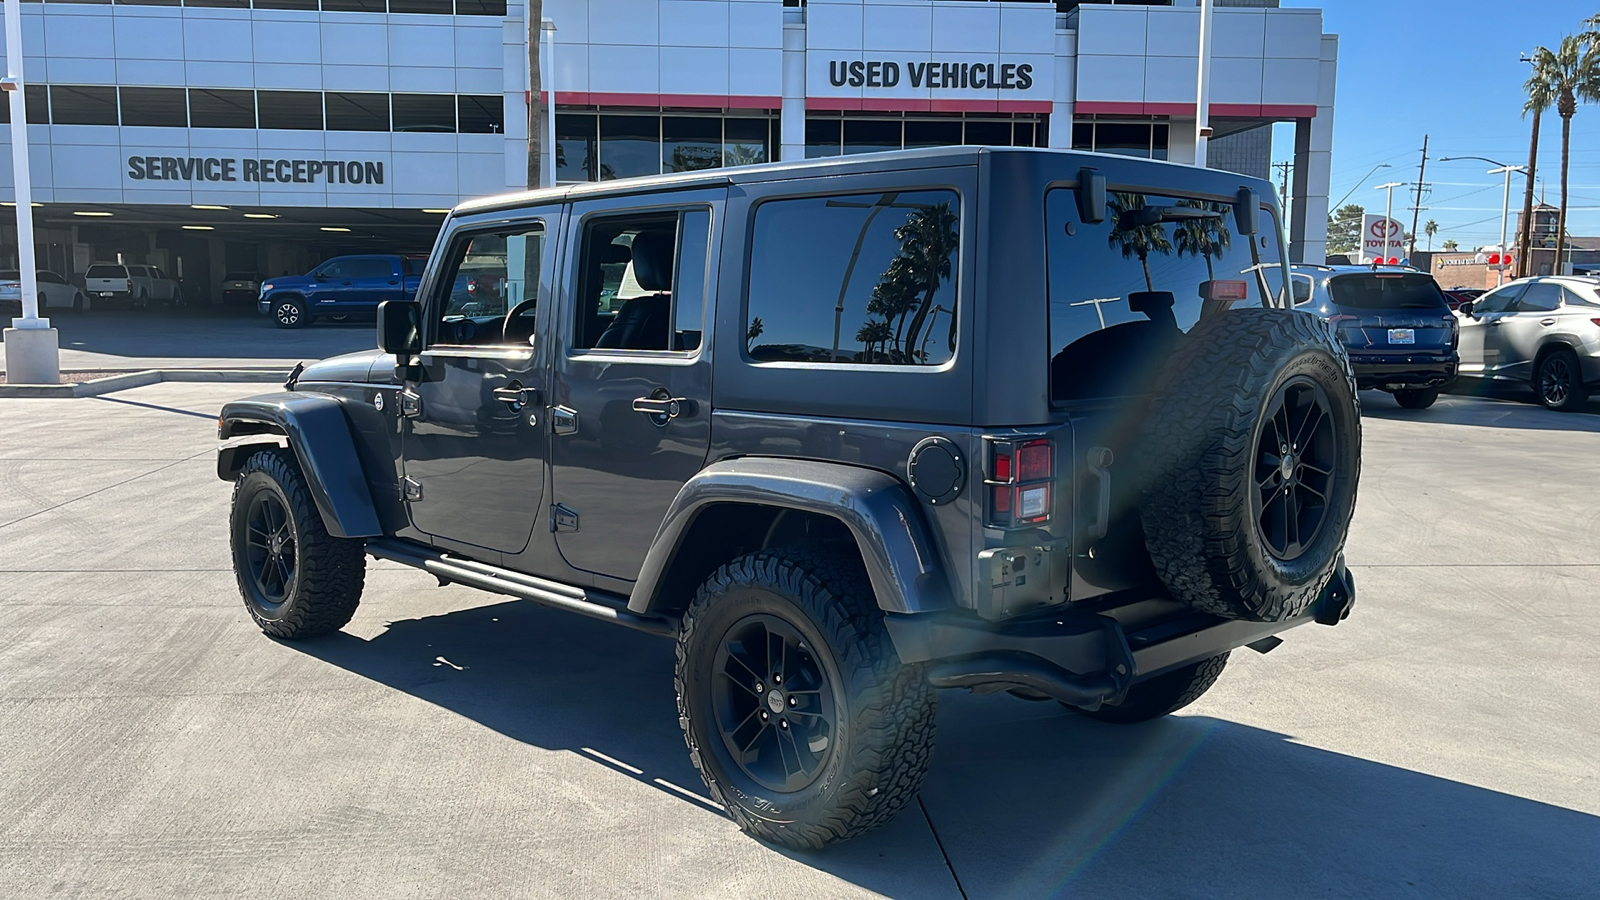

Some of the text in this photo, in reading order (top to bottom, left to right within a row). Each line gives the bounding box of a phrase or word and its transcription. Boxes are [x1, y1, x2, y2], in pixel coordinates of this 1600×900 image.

[829, 60, 1033, 90] USED VEHICLES
[128, 156, 384, 185] SERVICE RECEPTION
